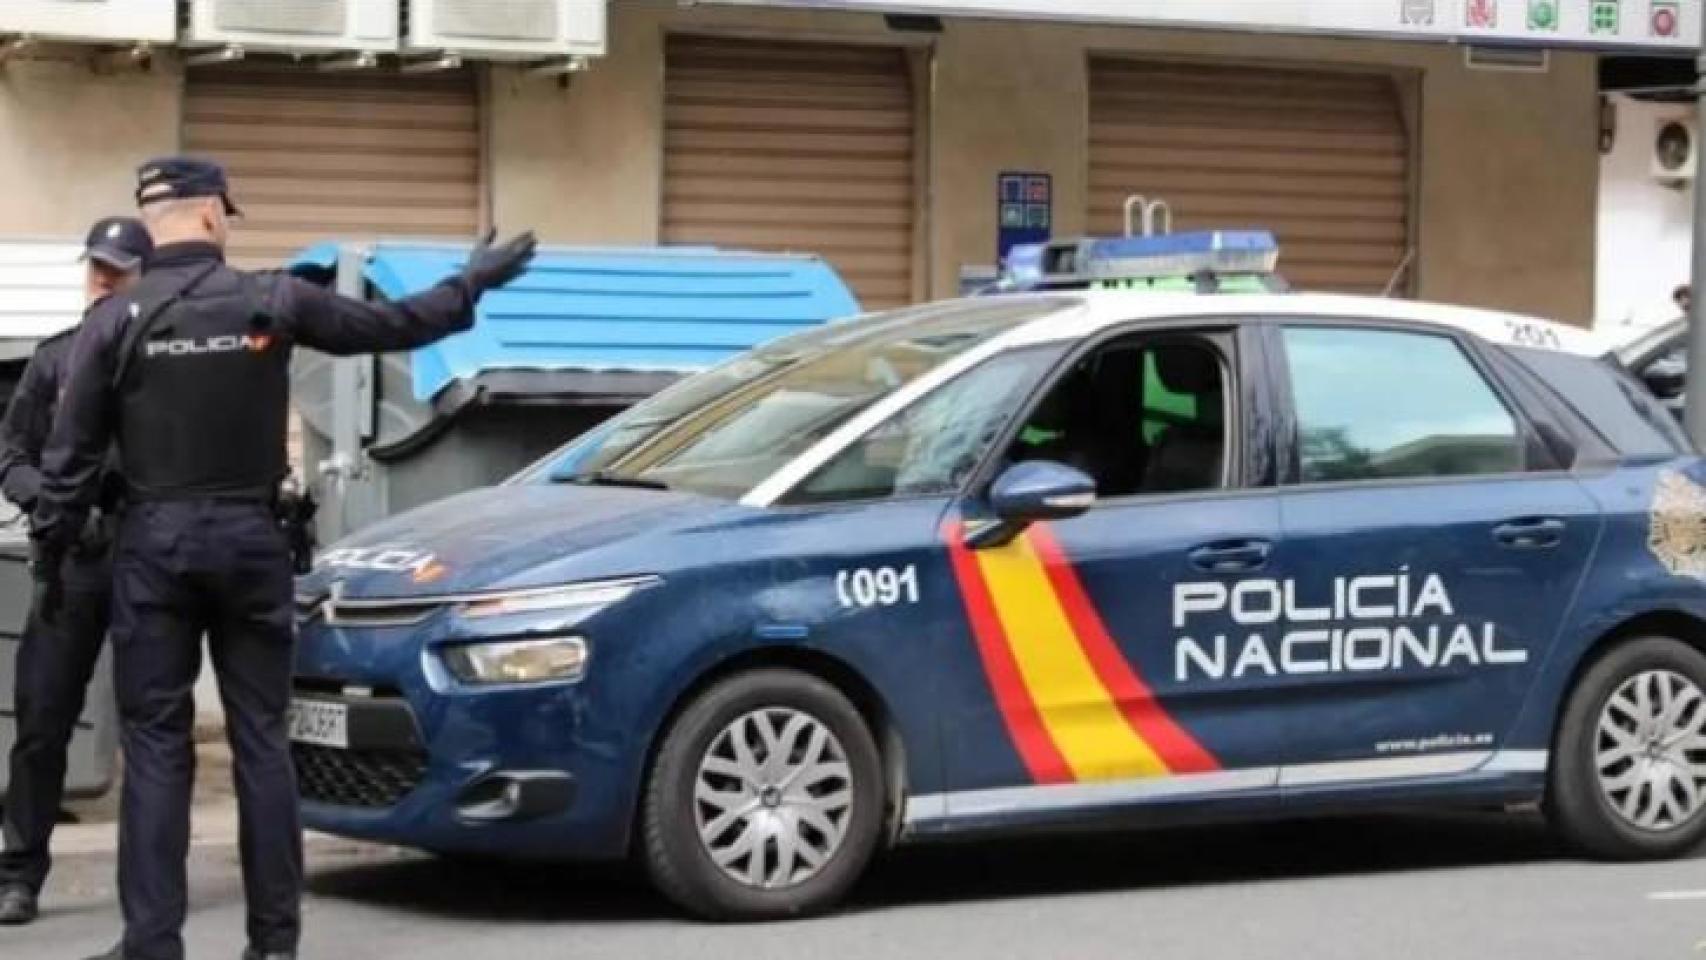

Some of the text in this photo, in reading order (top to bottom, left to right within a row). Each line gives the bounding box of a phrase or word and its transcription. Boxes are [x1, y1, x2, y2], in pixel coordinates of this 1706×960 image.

[146, 335, 252, 356] POLICIA
[1173, 564, 1454, 628] POLICÍA
[1174, 621, 1528, 681] NACIONAL
